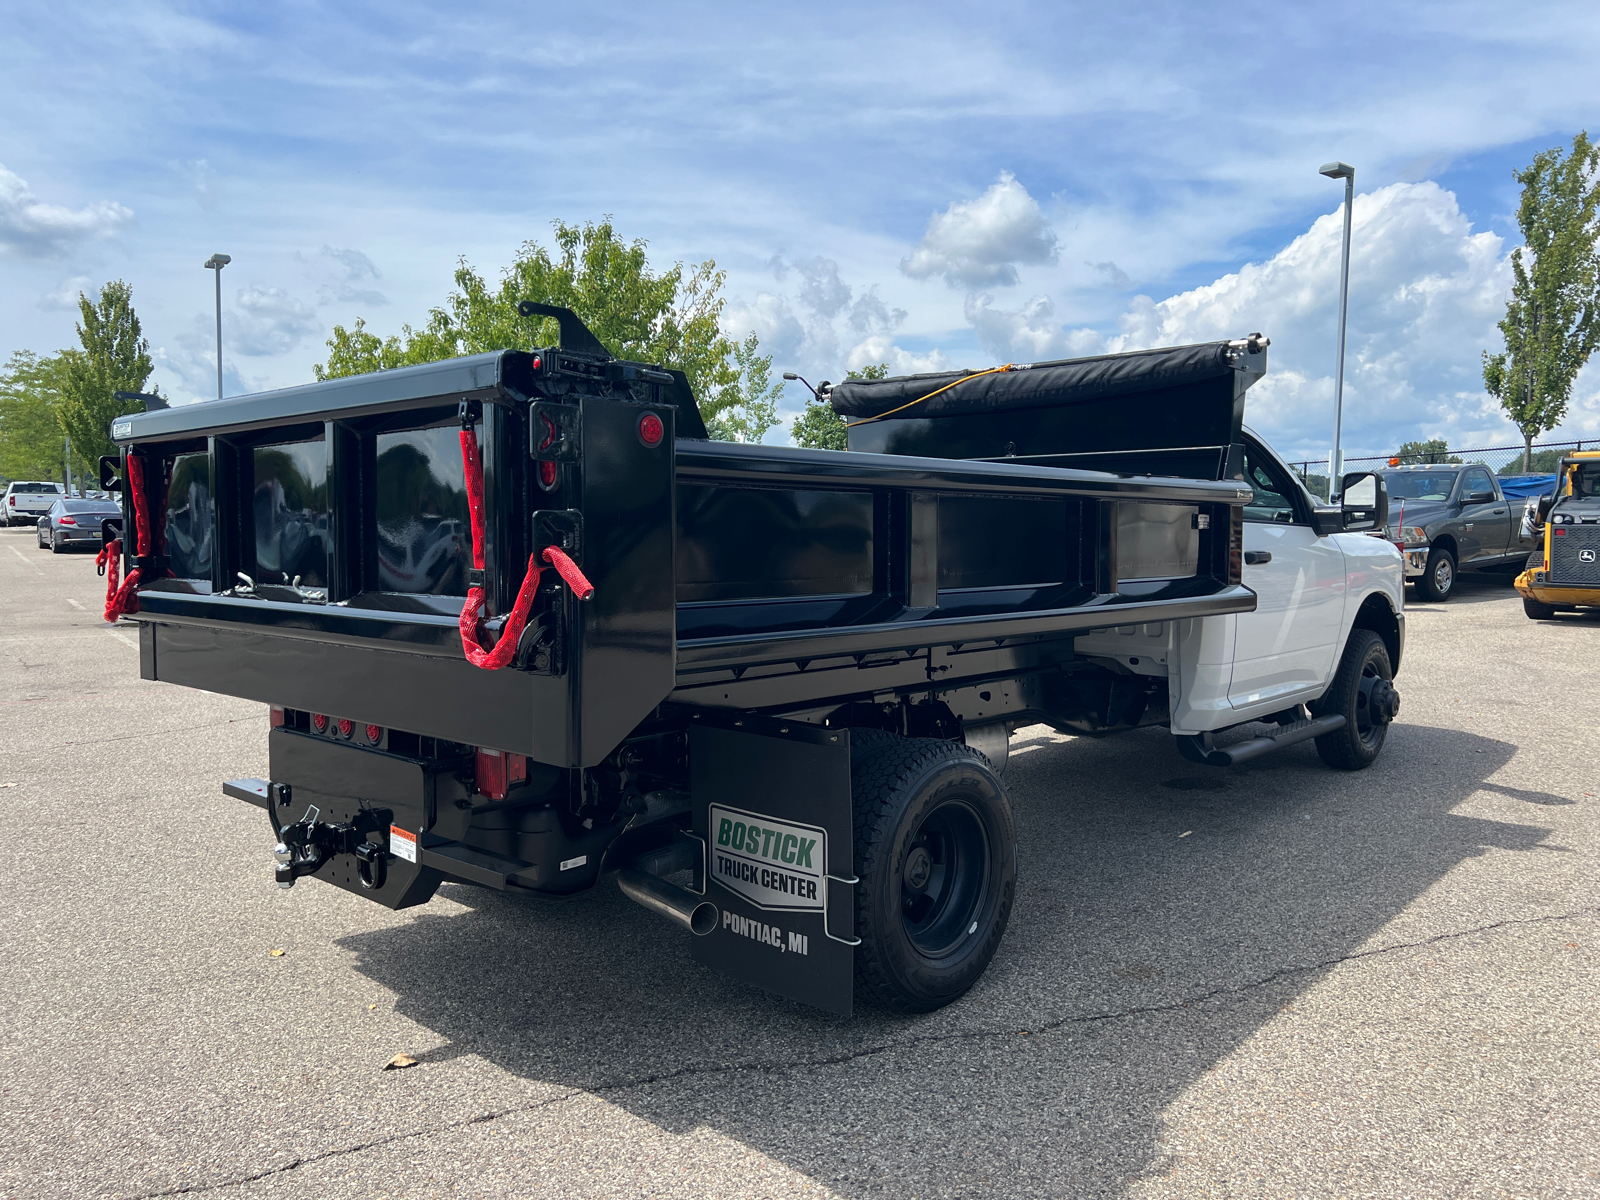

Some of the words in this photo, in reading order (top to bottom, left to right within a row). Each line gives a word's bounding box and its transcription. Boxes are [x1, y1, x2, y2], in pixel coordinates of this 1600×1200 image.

[395, 828, 415, 842] WARNING
[718, 818, 817, 869] BOSTICK
[717, 855, 759, 885] TRUCK
[761, 868, 817, 900] CENTER
[723, 910, 786, 953] PONTIAC,
[788, 931, 808, 956] MI
